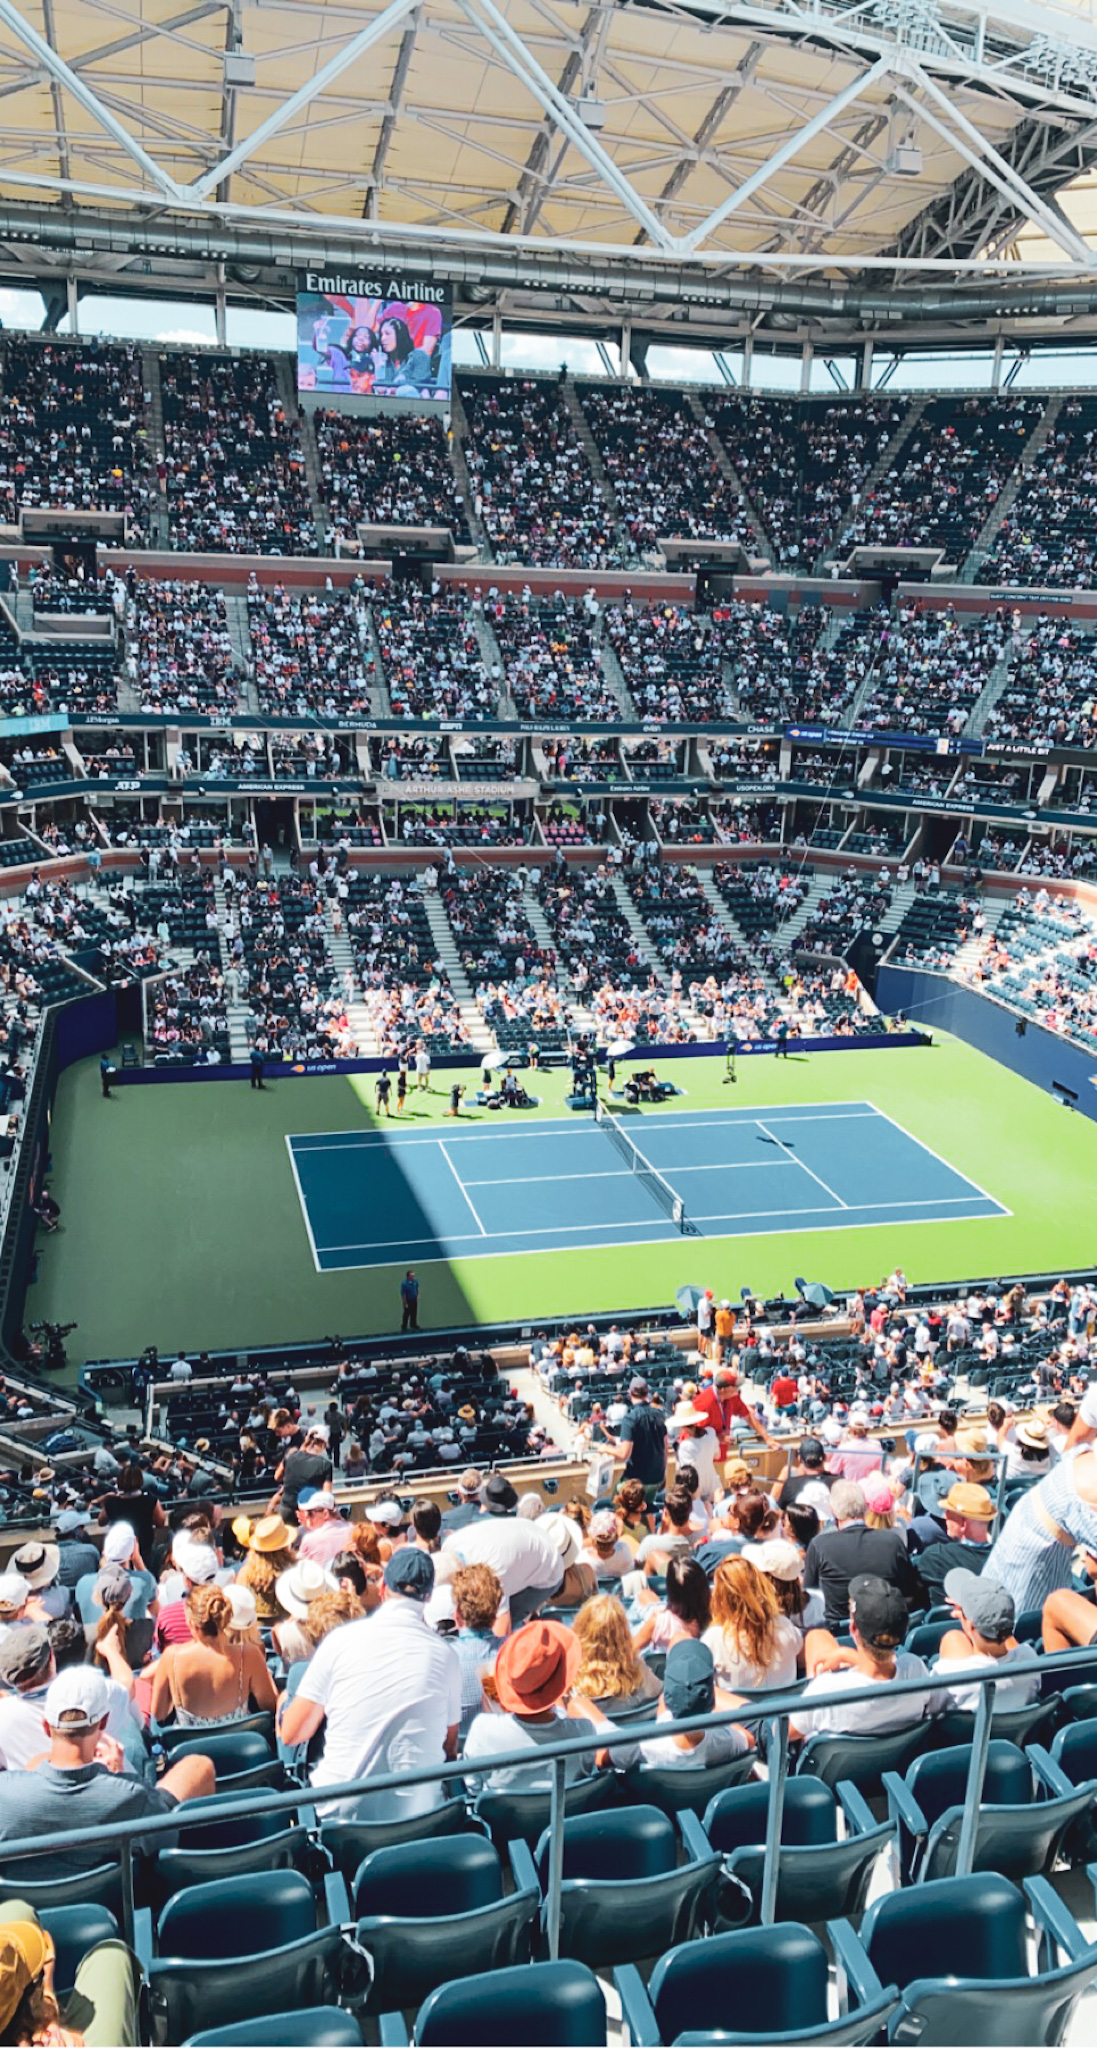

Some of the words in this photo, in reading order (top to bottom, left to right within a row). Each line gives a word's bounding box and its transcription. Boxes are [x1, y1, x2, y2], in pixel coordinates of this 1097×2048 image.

[306, 273, 382, 296] Emirates
[387, 280, 444, 302] Airline
[210, 716, 232, 727] IBM
[338, 720, 377, 729] BERMUDA
[440, 722, 463, 730] ESPN
[643, 724, 661, 733] evian
[747, 725, 775, 734] CHASE
[986, 743, 1005, 752] JUST
[1013, 746, 1036, 754] LITTLE
[1037, 747, 1050, 756] BIT
[115, 781, 141, 791] ATP
[405, 785, 442, 794] ARTHUR
[446, 786, 471, 794] ASHE
[474, 785, 515, 794] STADIUM
[912, 799, 944, 808] AMERICAN
[945, 803, 975, 812] EXPRESS
[317, 1064, 337, 1072] open
